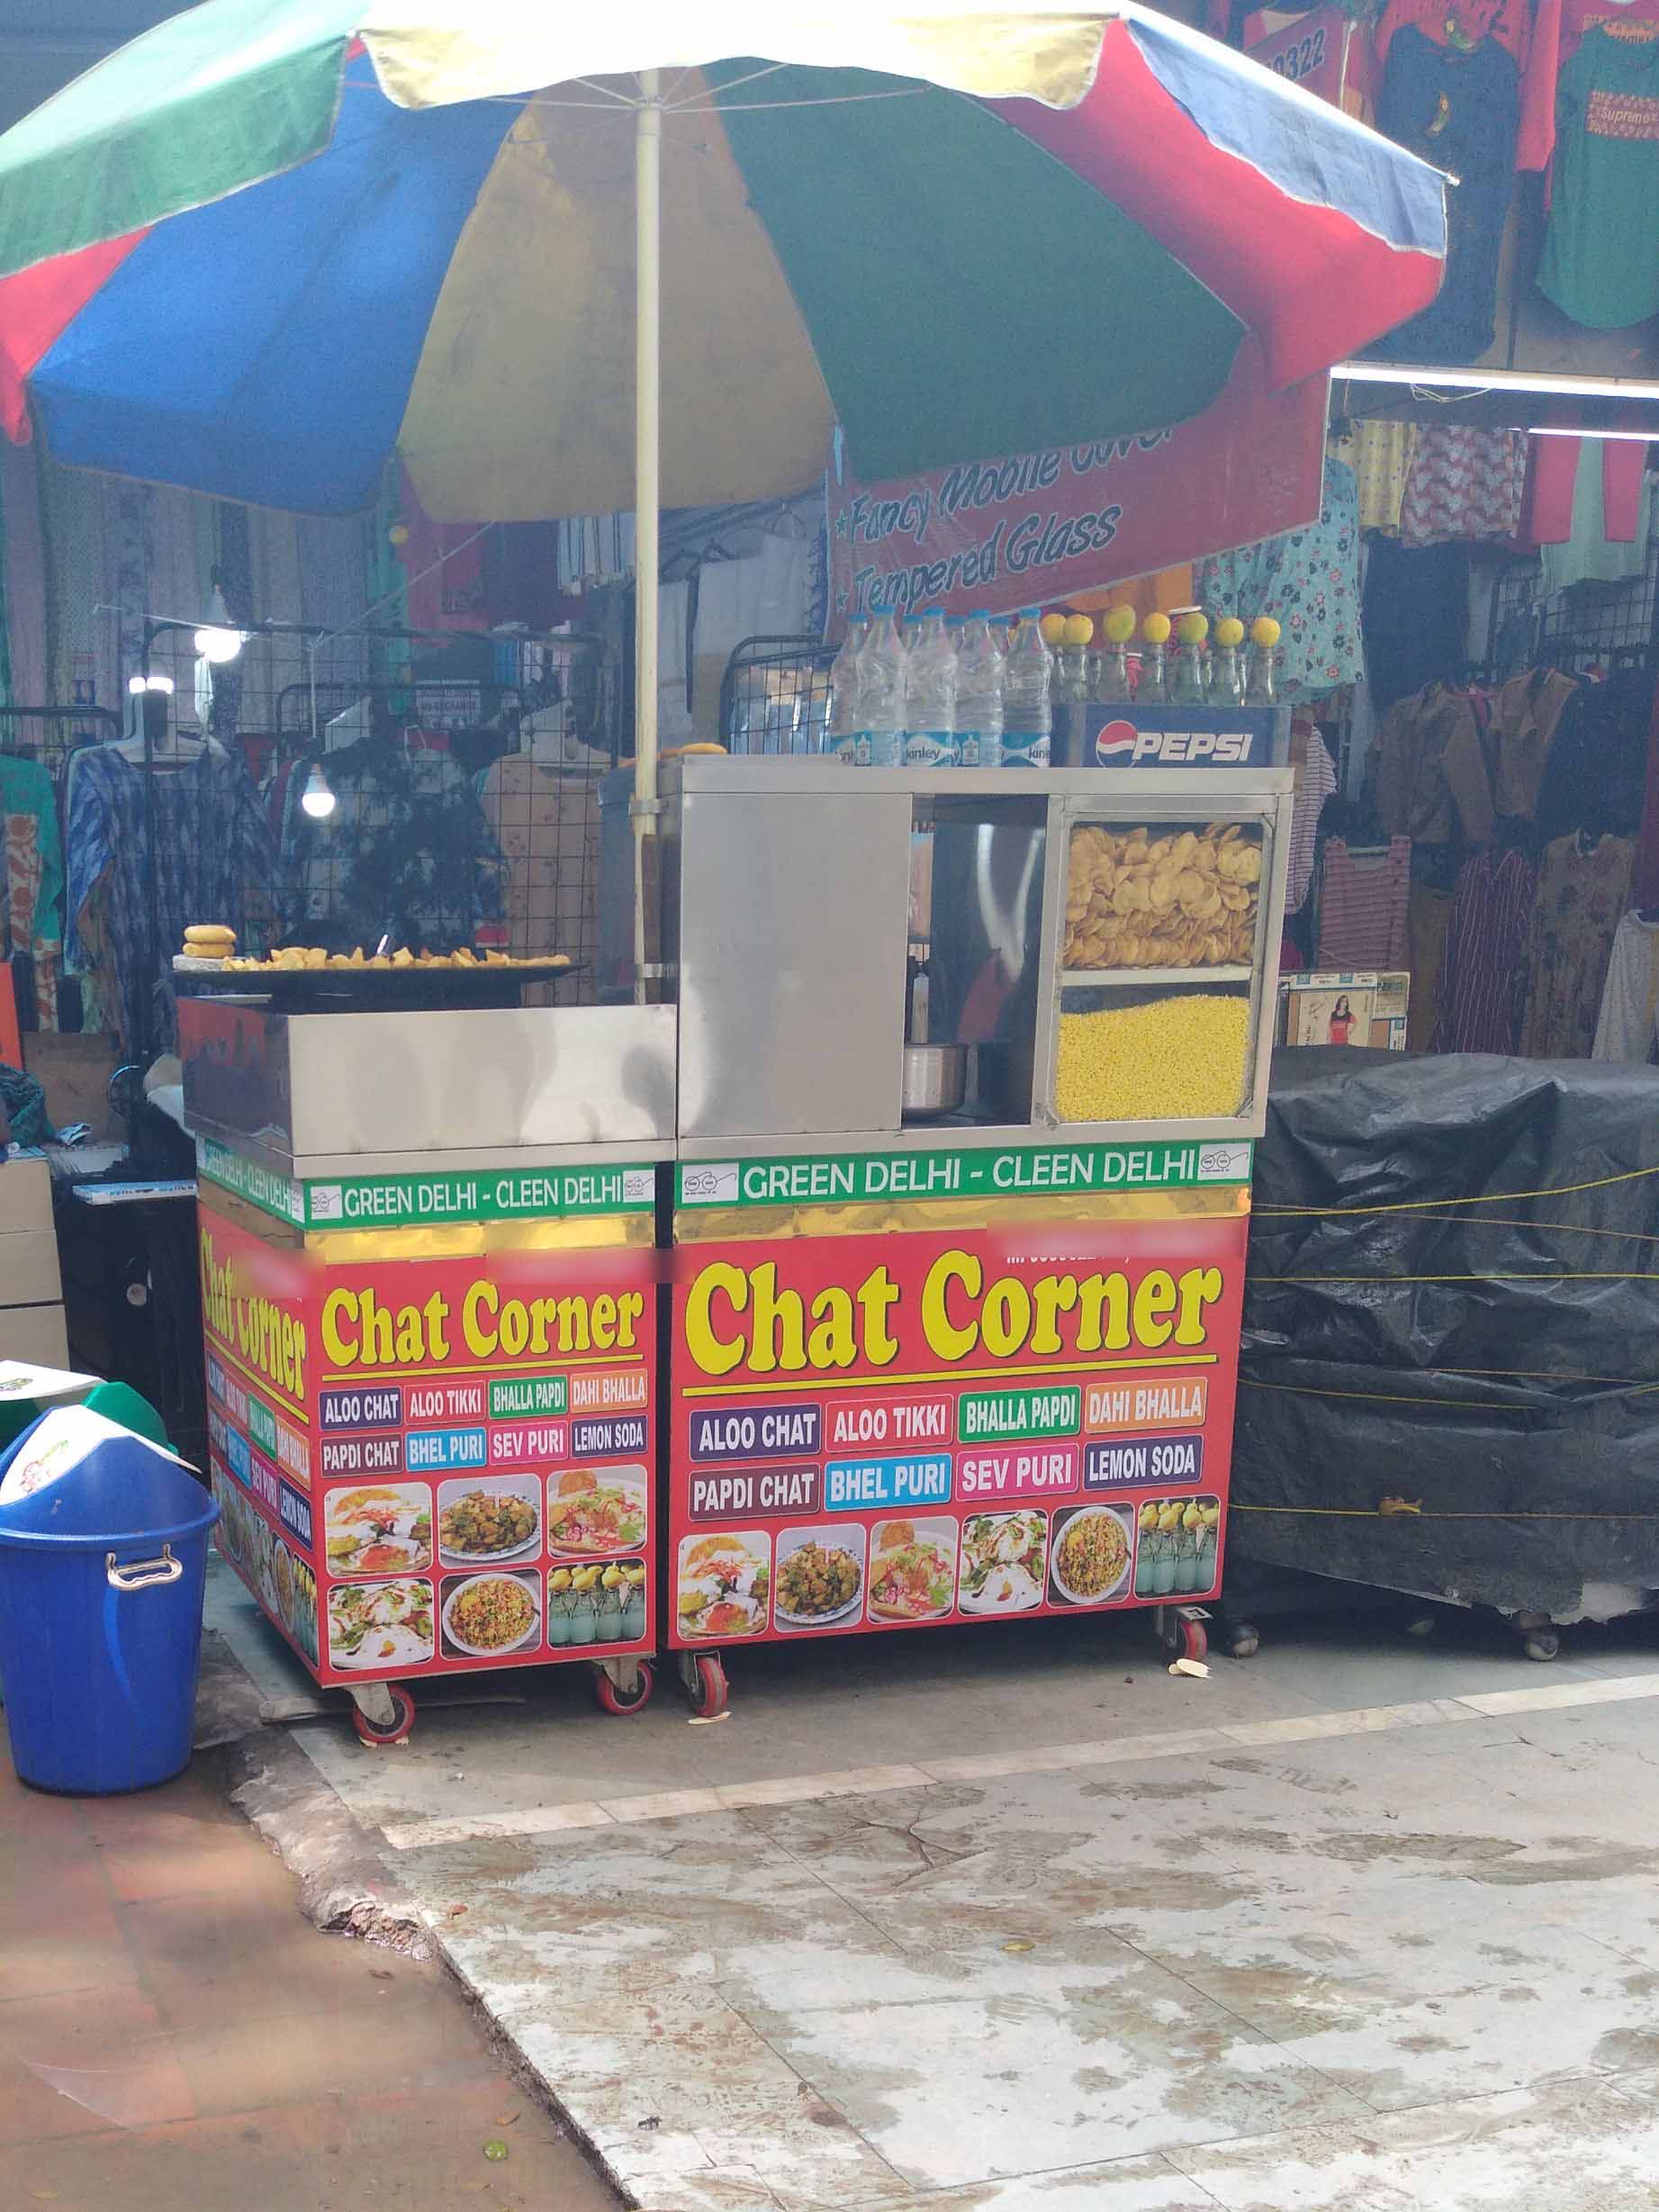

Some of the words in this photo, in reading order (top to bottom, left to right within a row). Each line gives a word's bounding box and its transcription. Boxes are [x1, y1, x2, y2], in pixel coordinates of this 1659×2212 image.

[850, 490, 932, 546] Fancy
[854, 518, 1007, 614] Tempered
[1005, 502, 1123, 574] Glass
[1132, 731, 1254, 763] PEPSI
[744, 1162, 854, 1200] GREEN
[865, 1158, 960, 1193] DELHI
[993, 1152, 1094, 1187] CLEEN
[1103, 1149, 1195, 1183] DELHI
[344, 1185, 413, 1218] GREEN
[419, 1182, 477, 1214] DELHI
[496, 1178, 558, 1209] CLEEN
[564, 1175, 621, 1205] DELHI
[321, 1287, 450, 1368] Chat
[463, 1279, 645, 1359] Corner
[685, 1261, 900, 1376] Chat
[921, 1249, 1223, 1361] Corner
[325, 1396, 360, 1423] ALOO
[364, 1394, 399, 1421] CHAT
[410, 1392, 444, 1417] ALOO
[446, 1388, 482, 1414] TIKKI
[494, 1385, 534, 1413] BHALLA
[536, 1382, 564, 1408] PAPDI
[573, 1380, 600, 1406] DAHI
[602, 1377, 645, 1404] BHALLA
[1089, 1391, 1130, 1425] DAHI
[1135, 1386, 1203, 1421] BHALLA
[699, 1417, 755, 1452] ALOO
[762, 1413, 816, 1448] CHAT
[834, 1408, 888, 1442] ALOO
[893, 1404, 946, 1438] TIKKI
[966, 1398, 1027, 1434] BHALLA
[1032, 1394, 1076, 1429] PAPDI
[323, 1444, 361, 1470] PAPDI
[365, 1440, 400, 1467] CHAT
[410, 1437, 446, 1464] BHEL
[450, 1434, 482, 1461] PURI
[493, 1431, 524, 1458] SEV
[527, 1428, 564, 1455] PURI
[574, 1425, 612, 1451] LEMON
[615, 1422, 644, 1448] SODA
[962, 1458, 1009, 1492] SEV
[1016, 1453, 1071, 1488] PURI
[1089, 1447, 1147, 1482] LEMON
[1151, 1444, 1195, 1476] SODA
[693, 1476, 753, 1512] PAPDI
[760, 1473, 815, 1509] CHAT
[830, 1467, 888, 1503] BHEL
[895, 1463, 944, 1497] PURI
